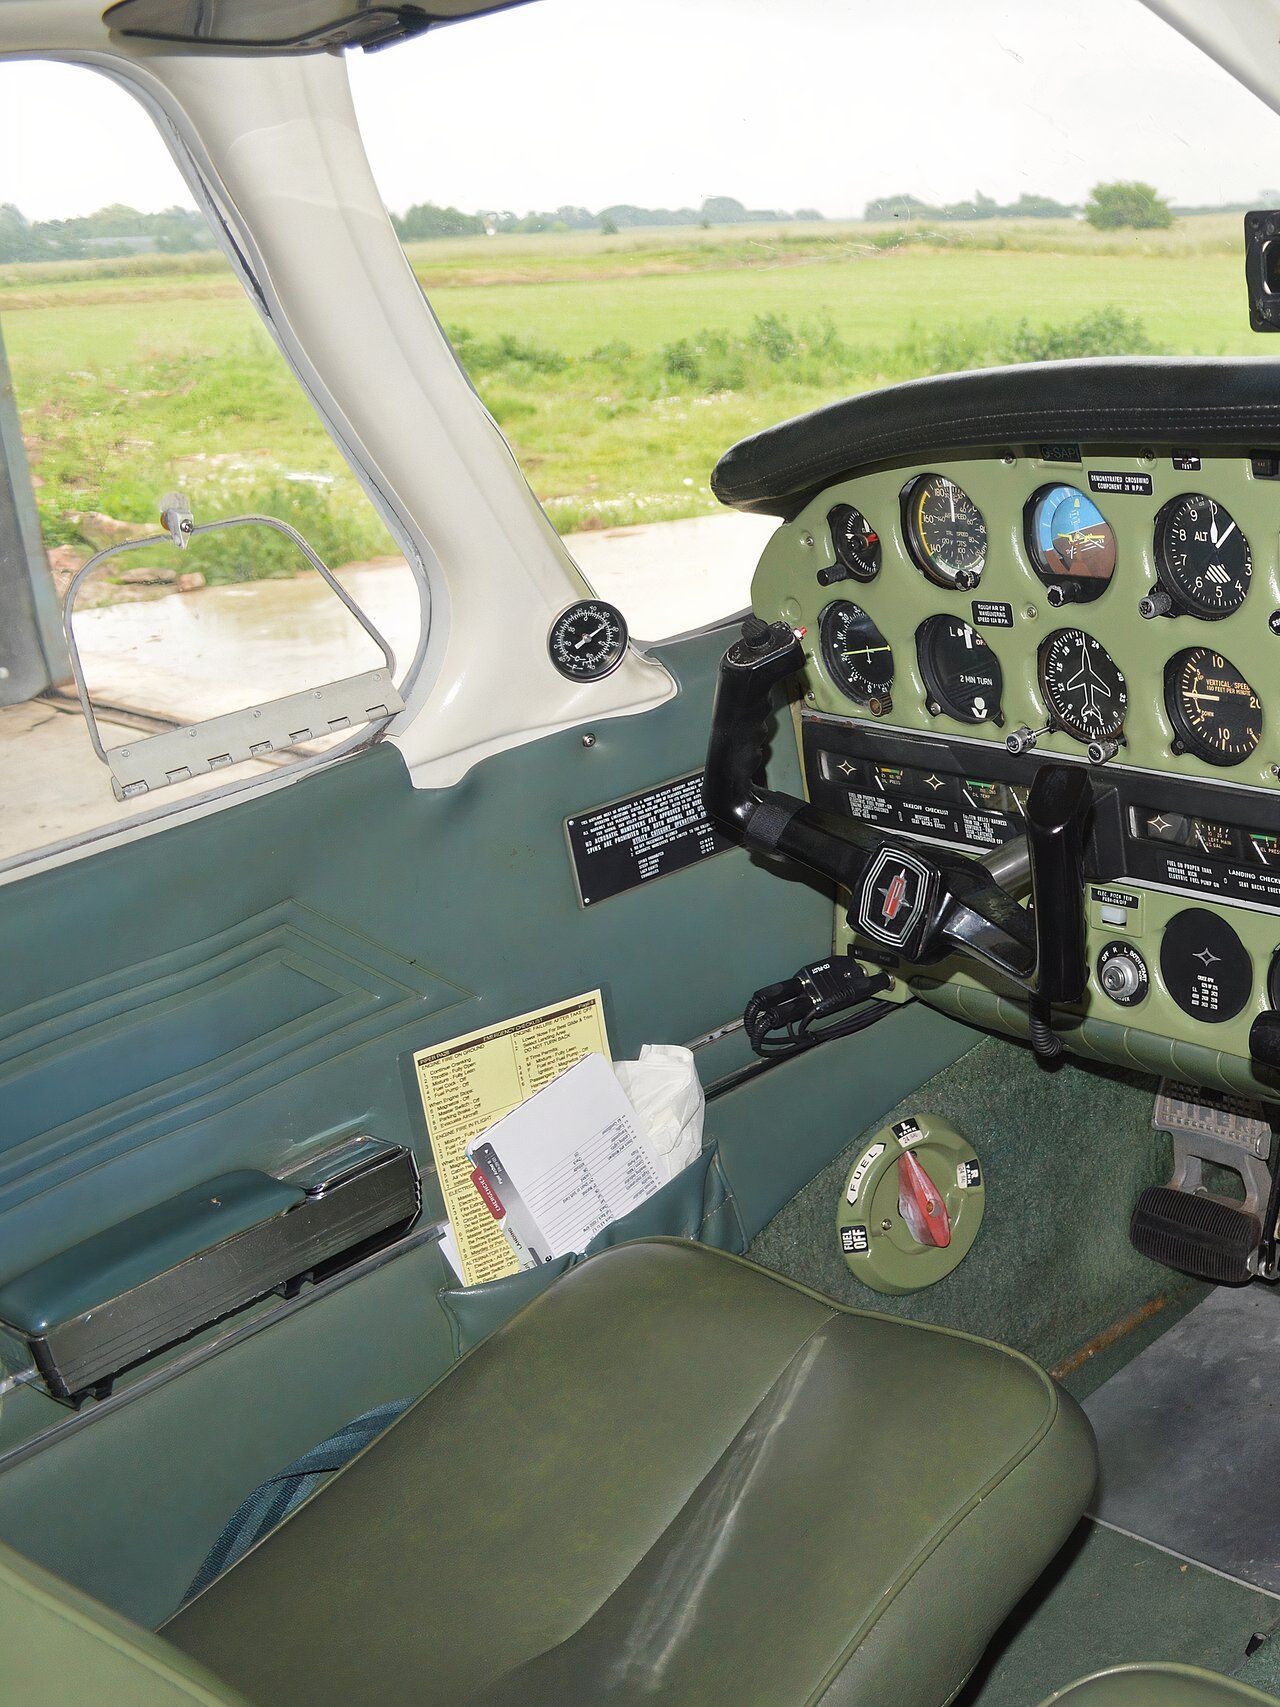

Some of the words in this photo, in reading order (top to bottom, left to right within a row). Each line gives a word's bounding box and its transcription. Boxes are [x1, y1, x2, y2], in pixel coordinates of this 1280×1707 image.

[1190, 510, 1198, 521] 9
[1179, 529, 1187, 541] 8
[1194, 531, 1209, 541] ALT
[930, 543, 941, 552] 140
[1180, 554, 1188, 566] 7
[1195, 576, 1203, 588] 6
[1234, 580, 1242, 591] 4
[1215, 586, 1223, 597] 5
[1212, 655, 1224, 668] 10
[977, 677, 993, 686] TURN
[1206, 679, 1230, 688] VERTICAL
[1218, 728, 1230, 740] 10
[1228, 869, 1256, 880] LANDING
[513, 1027, 533, 1038] ENGINE
[533, 1020, 554, 1031] FAILURE
[554, 1014, 570, 1023] AFTER
[421, 1060, 441, 1071] ENGINE
[441, 1056, 454, 1064] FIRE
[899, 1126, 917, 1137] TANK
[902, 1122, 910, 1131] L
[850, 1151, 878, 1193] FUEL
[478, 1175, 501, 1213] EMERGENCIES
[843, 1230, 854, 1250] FUEL
[853, 1228, 867, 1249] OFF
